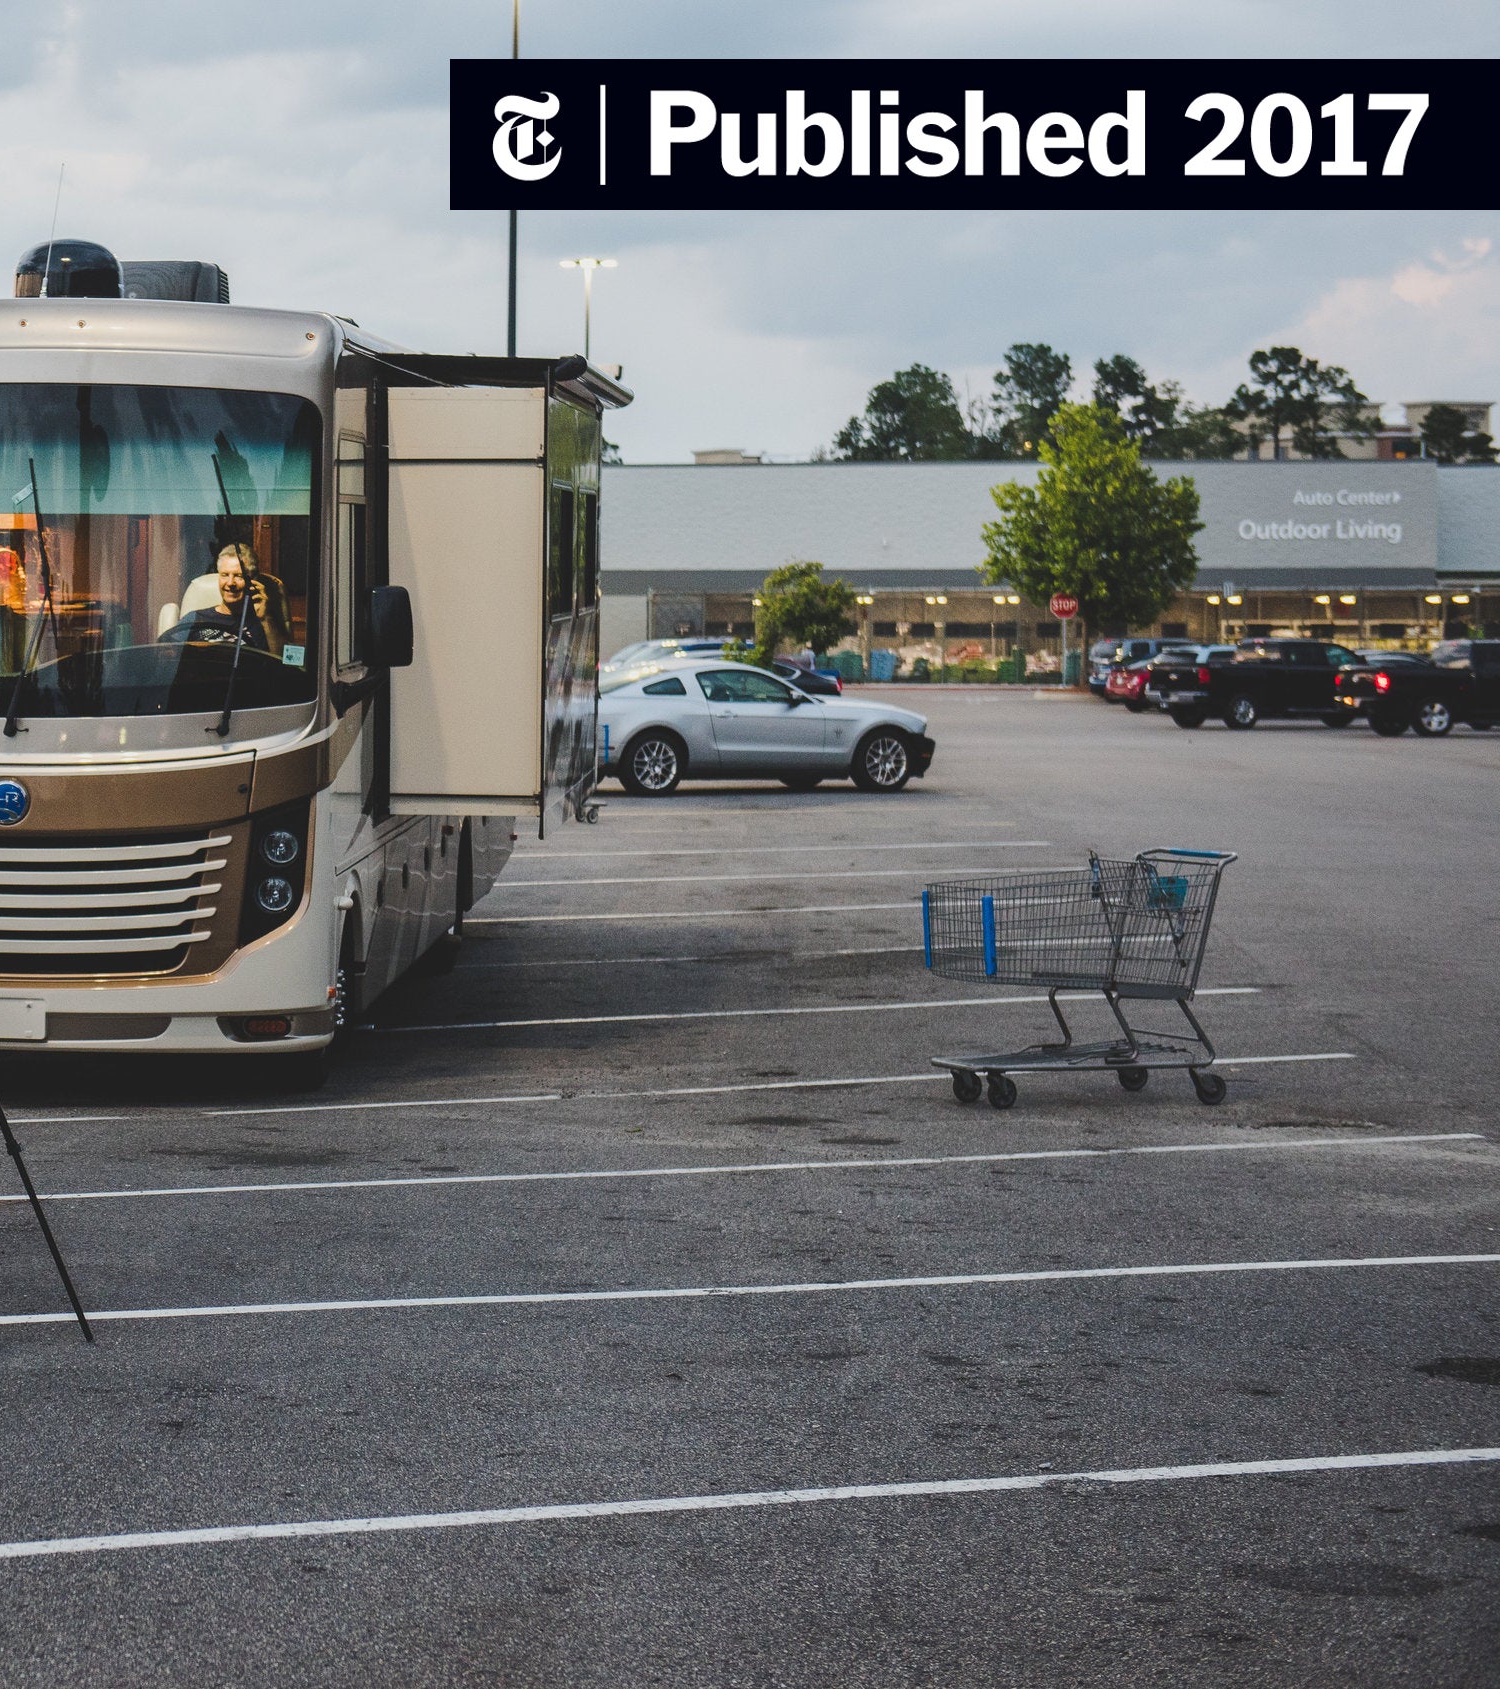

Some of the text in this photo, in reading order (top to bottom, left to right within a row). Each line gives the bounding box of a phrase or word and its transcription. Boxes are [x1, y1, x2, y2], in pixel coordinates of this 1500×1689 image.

[1293, 489, 1391, 506] Auto Center
[1238, 518, 1403, 544] Outdoor Living
[1052, 599, 1076, 611] STOP
